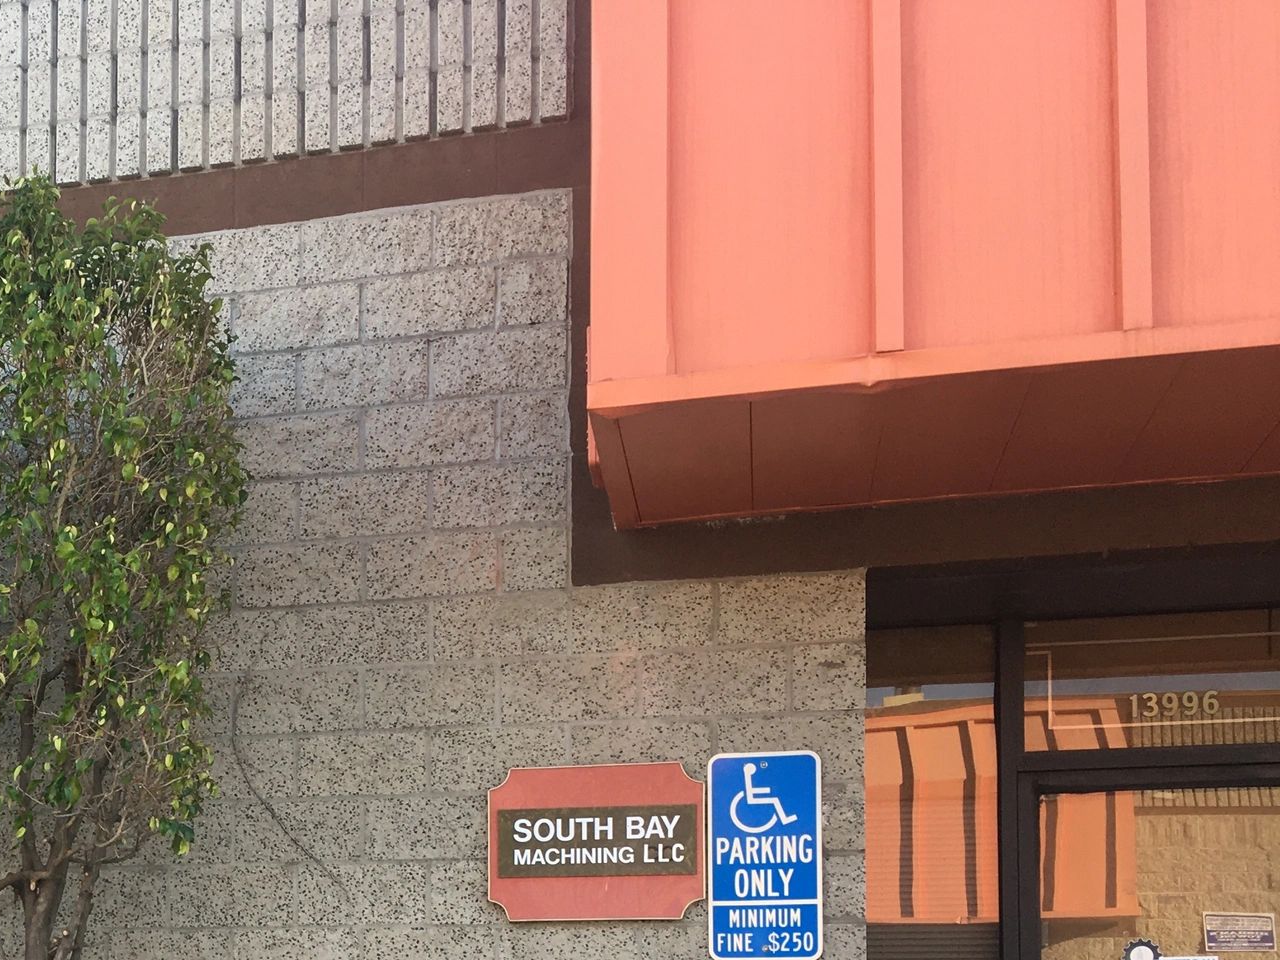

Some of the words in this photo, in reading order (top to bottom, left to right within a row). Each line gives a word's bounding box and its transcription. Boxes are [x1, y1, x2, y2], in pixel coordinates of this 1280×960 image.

[1129, 690, 1220, 718] 13996
[513, 817, 613, 842] SOUTH
[625, 815, 681, 839] BAY
[513, 847, 634, 865] MACHINING
[642, 843, 685, 863] LLC
[716, 834, 813, 864] PARKING
[734, 868, 794, 897] ONLY
[729, 908, 801, 928] MINIMUM
[717, 933, 753, 952] FINE
[768, 932, 814, 953] $250
